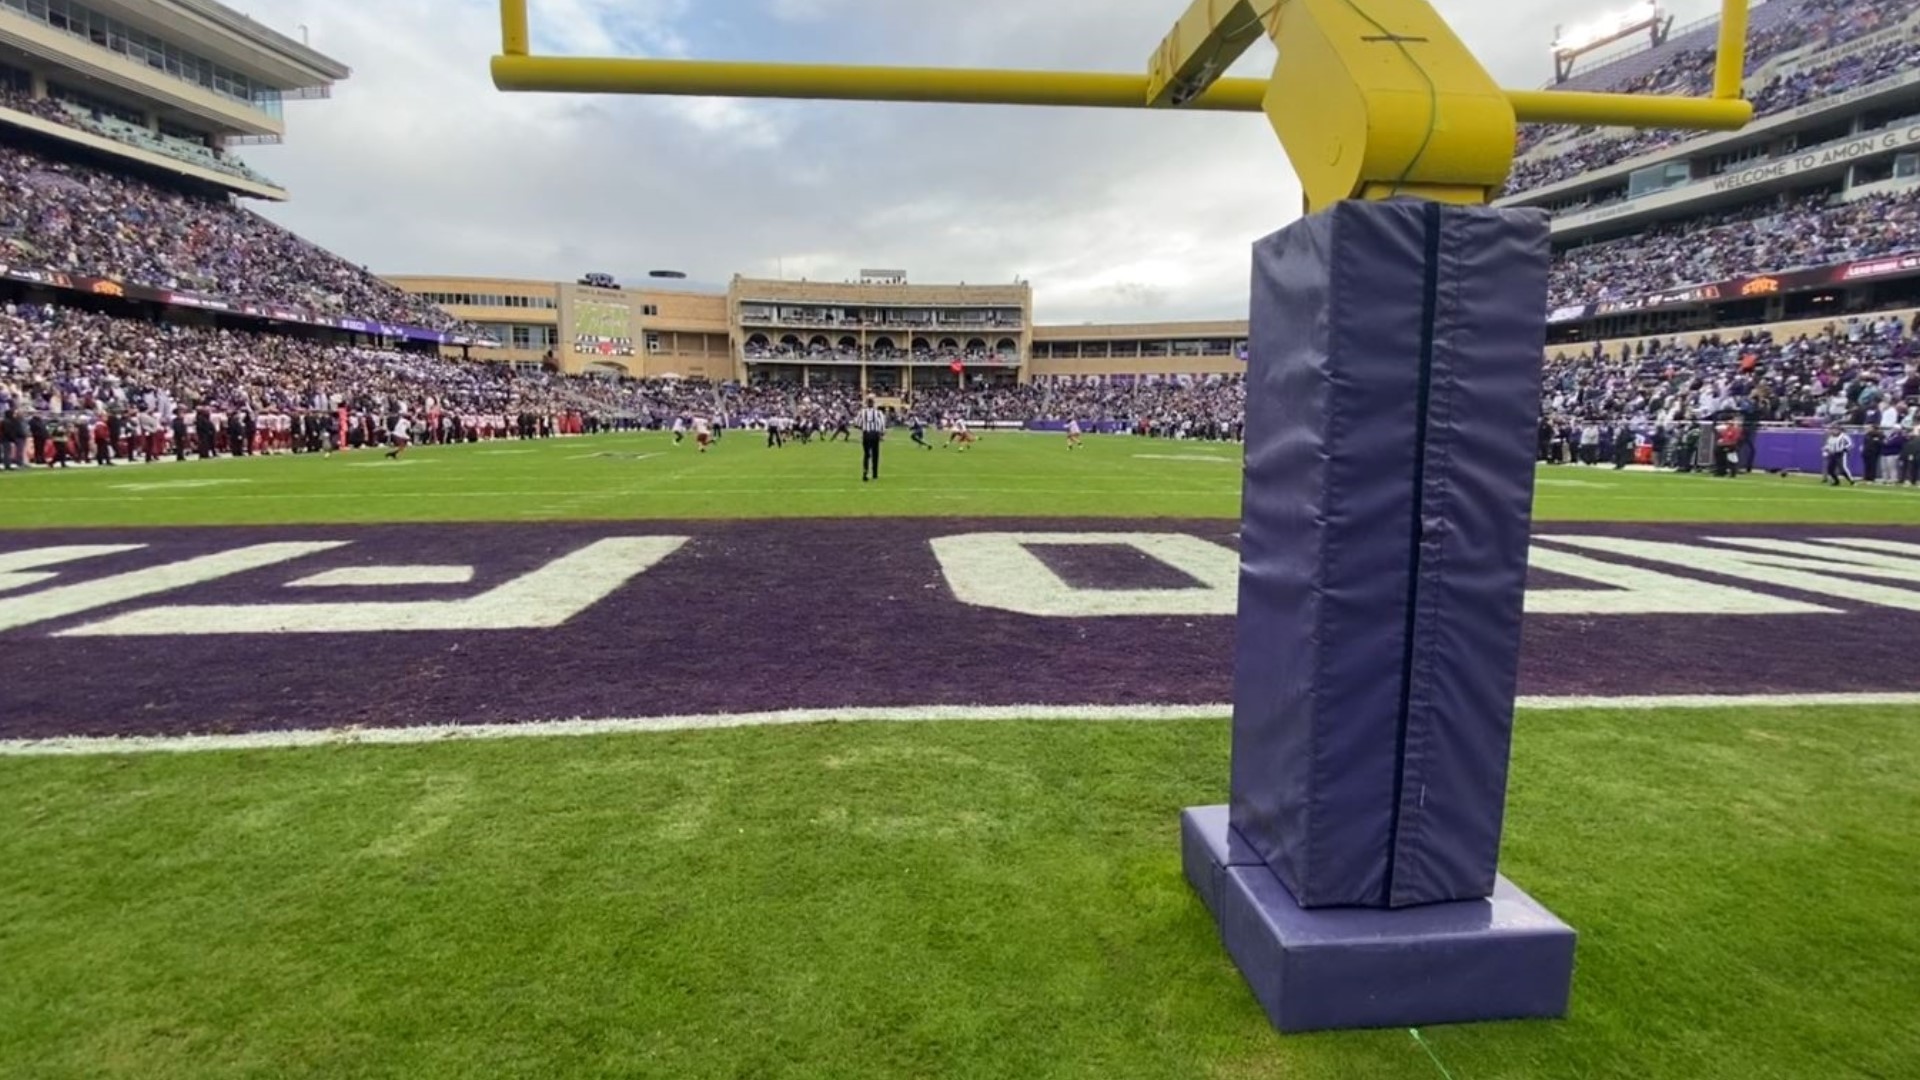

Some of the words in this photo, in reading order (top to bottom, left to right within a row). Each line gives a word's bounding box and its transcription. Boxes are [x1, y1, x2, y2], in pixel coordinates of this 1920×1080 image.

[1713, 163, 1786, 190] WELCOME
[1794, 155, 1815, 171] TO
[1821, 139, 1875, 165] AMON
[1882, 133, 1899, 147] G.
